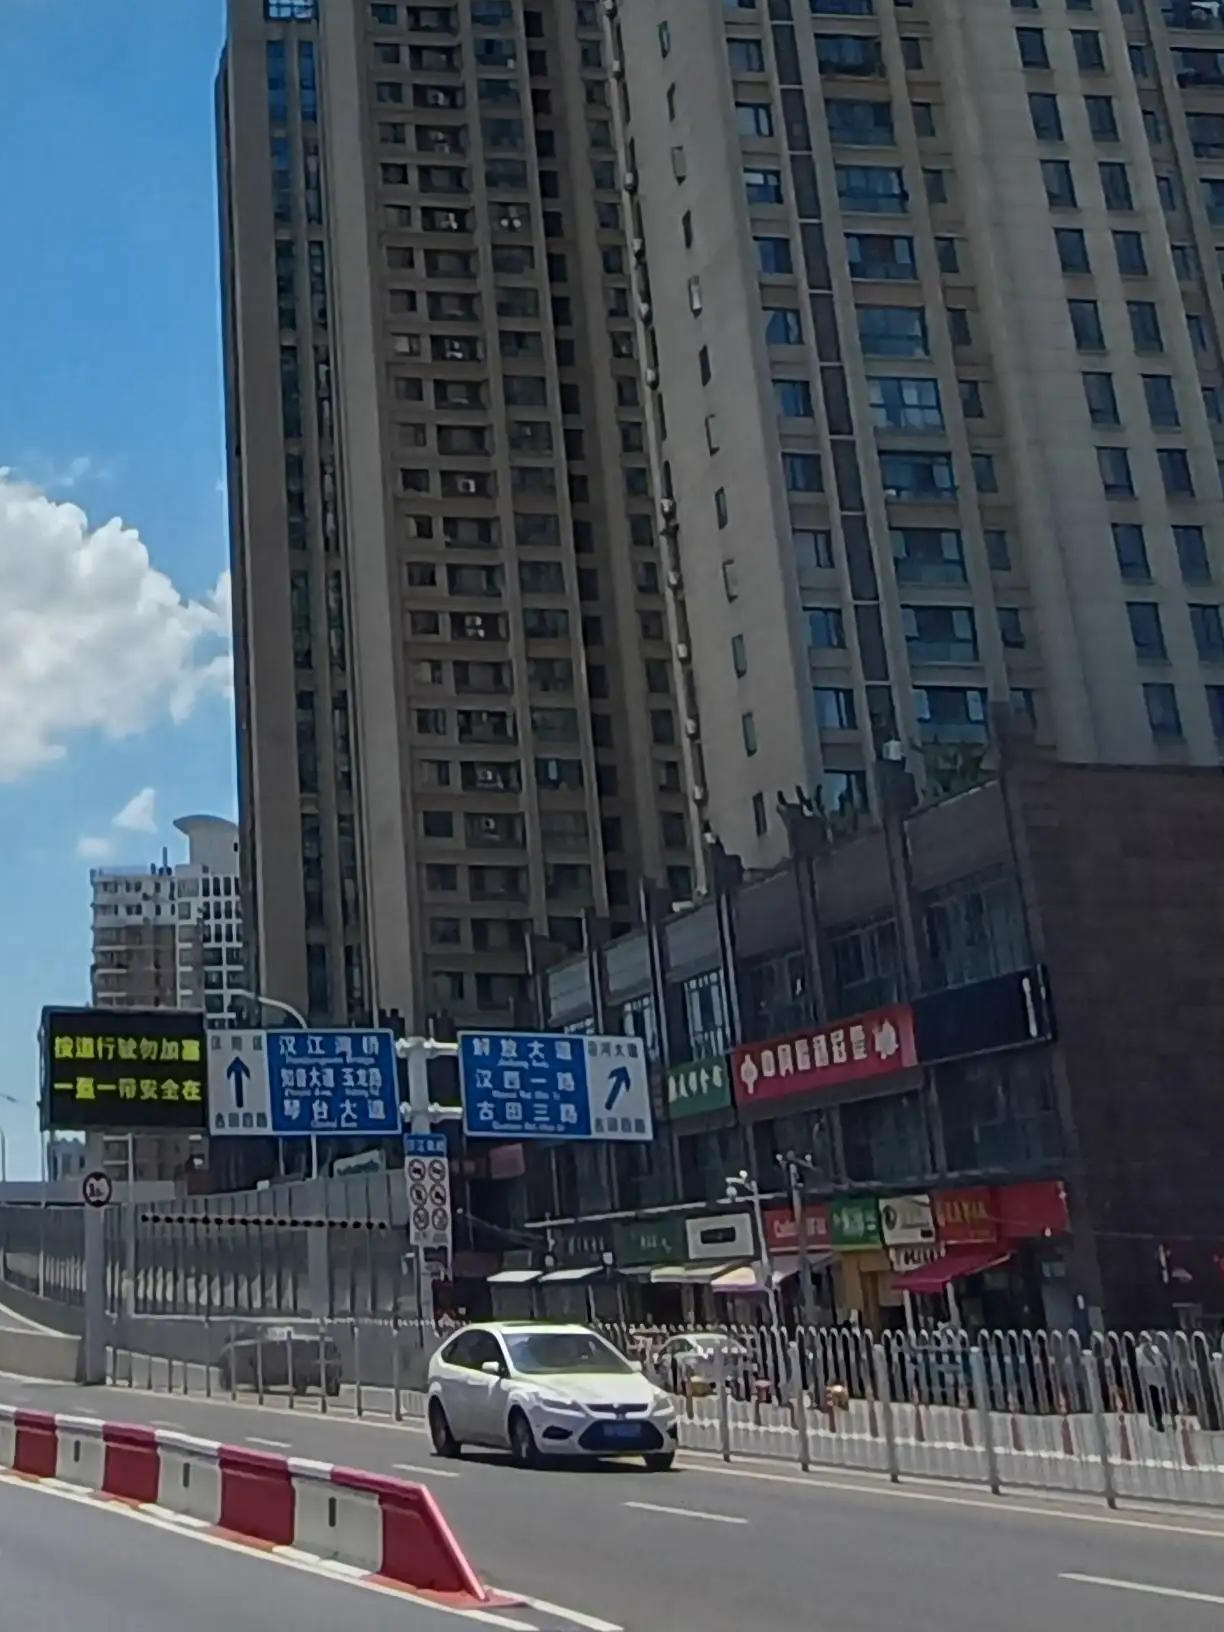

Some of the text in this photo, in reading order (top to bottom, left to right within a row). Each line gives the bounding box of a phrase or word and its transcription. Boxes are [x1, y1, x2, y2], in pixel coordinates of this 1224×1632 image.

[472, 1037, 572, 1061] 解放大道
[475, 1068, 575, 1092] 汉西一路
[476, 1100, 578, 1124] 古田三路
